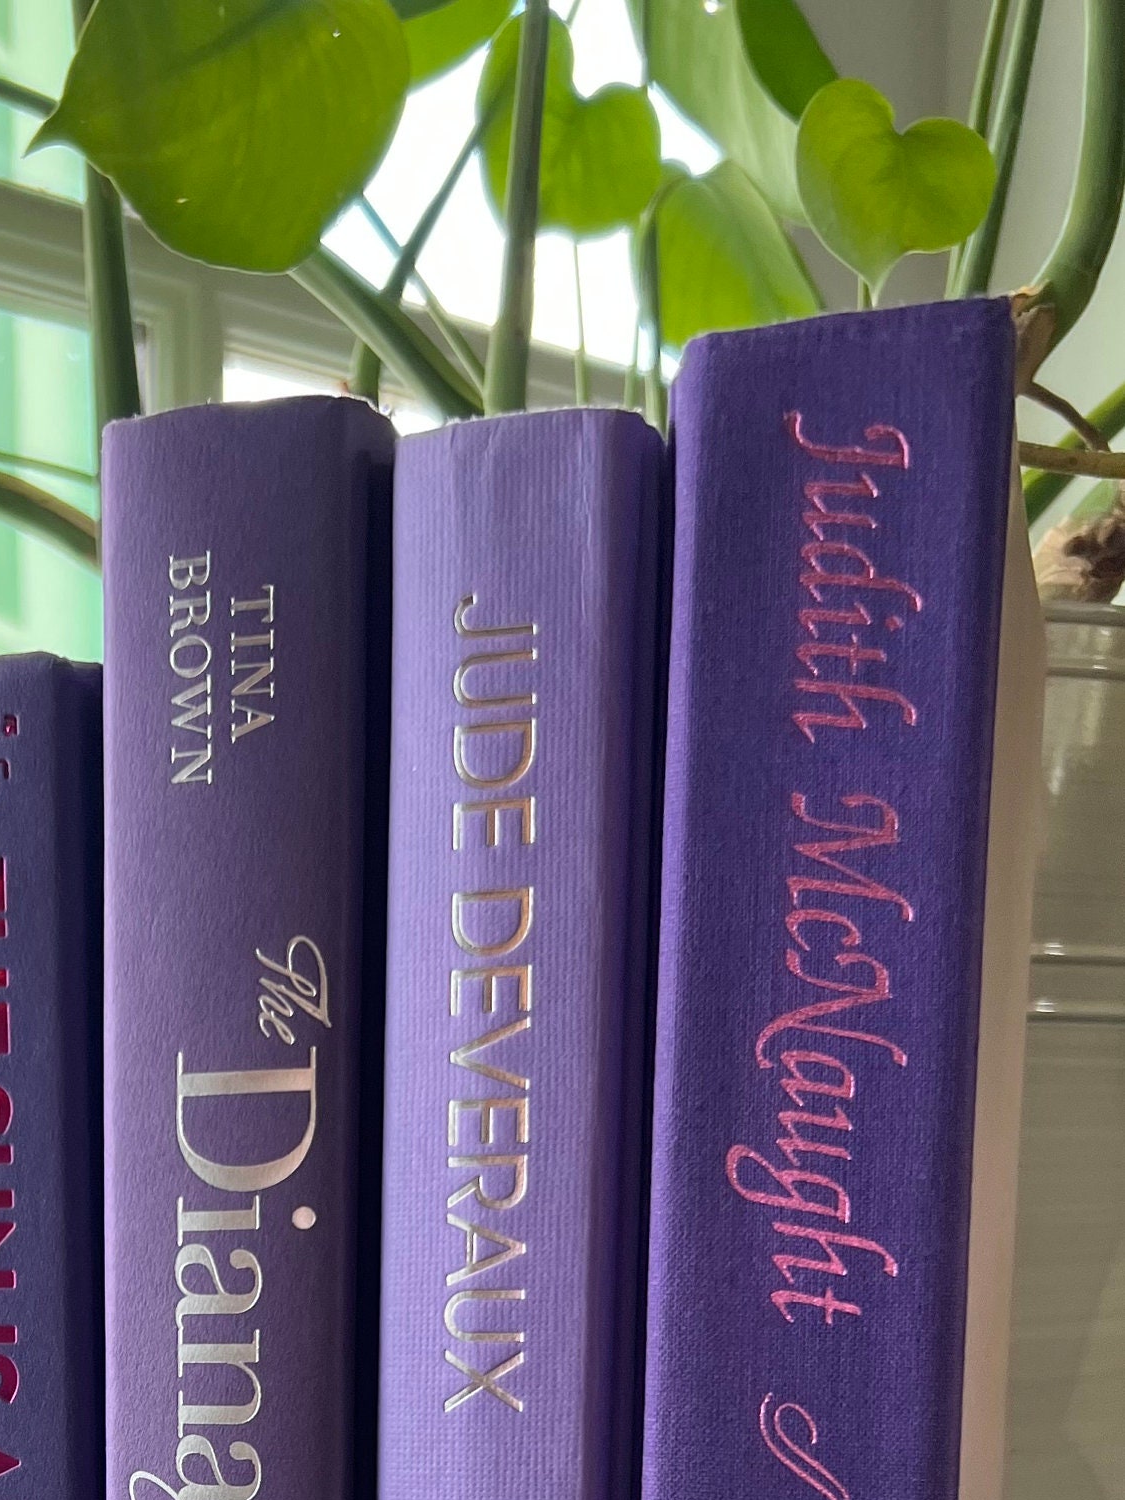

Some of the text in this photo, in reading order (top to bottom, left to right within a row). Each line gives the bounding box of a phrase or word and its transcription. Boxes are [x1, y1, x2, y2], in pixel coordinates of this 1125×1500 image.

[168, 550, 213, 786] BROWN
[229, 583, 275, 744] TINA
[725, 410, 924, 1325] Judith McNaught
[255, 935, 332, 1046] The
[443, 592, 538, 1413] JUDE DEVERAUX
